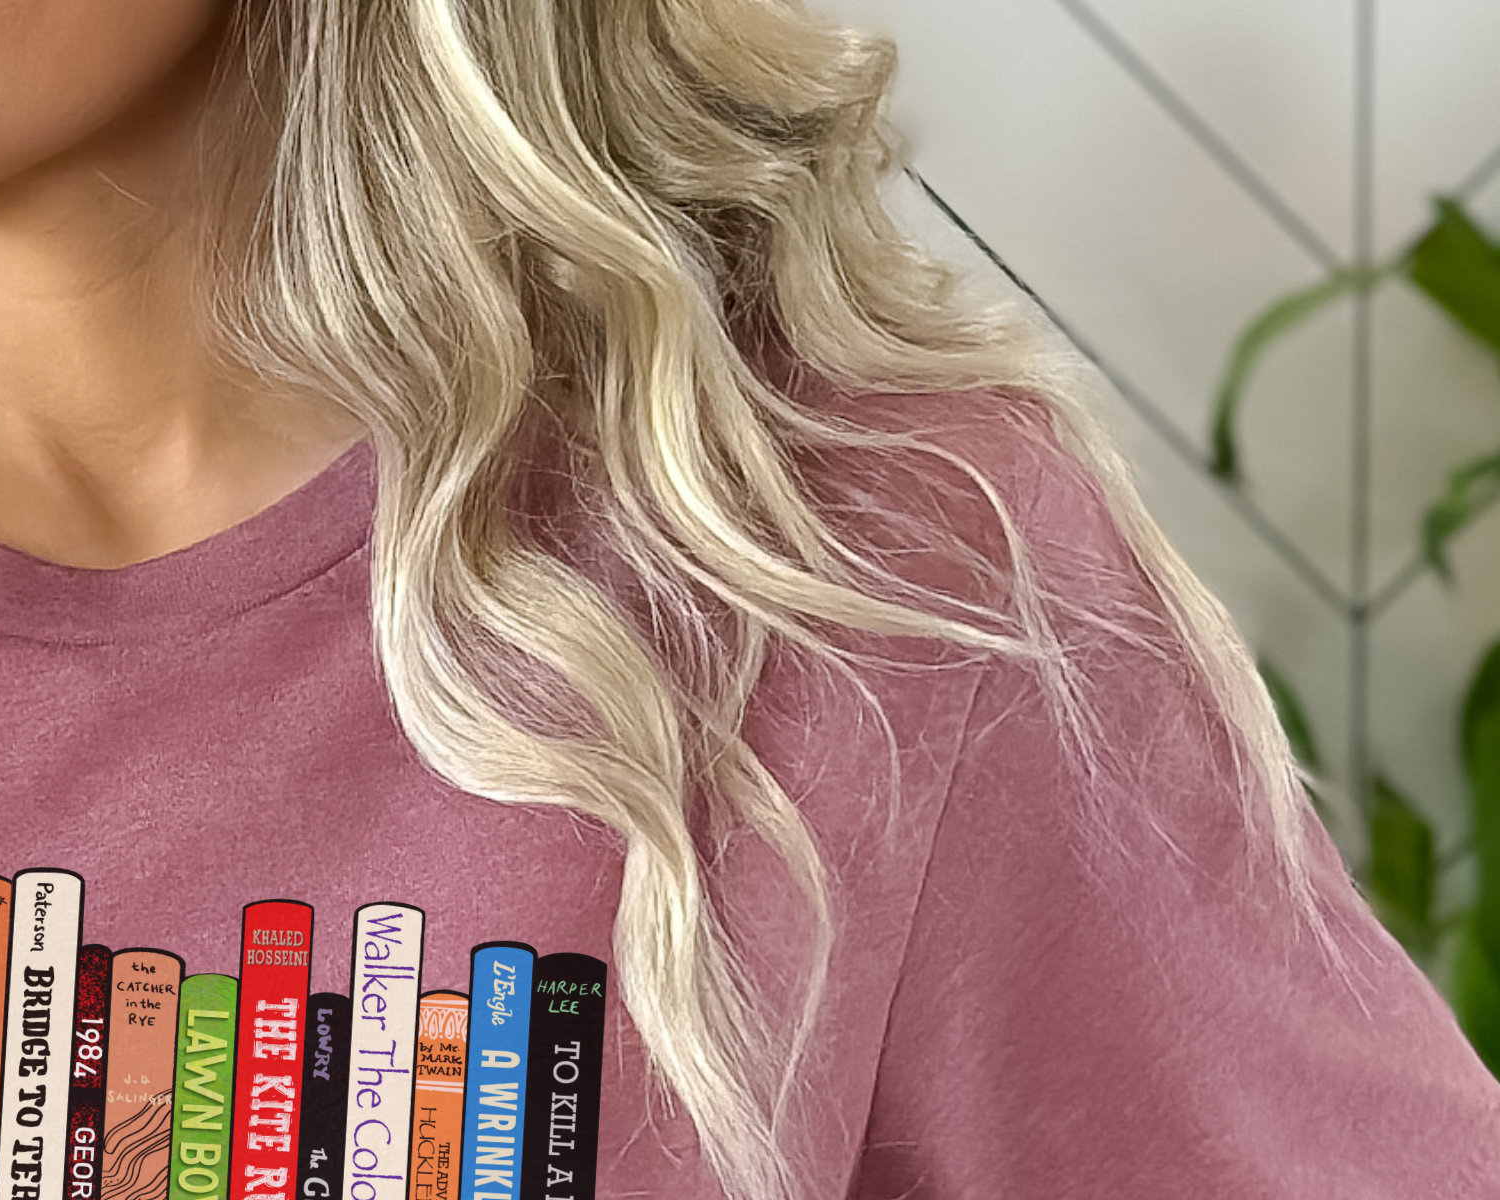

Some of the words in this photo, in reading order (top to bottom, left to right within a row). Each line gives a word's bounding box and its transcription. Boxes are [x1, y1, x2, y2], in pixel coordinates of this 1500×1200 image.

[30, 882, 54, 952] Paterson
[252, 929, 305, 947] KHALED
[132, 962, 156, 974] the
[247, 949, 309, 967] HOSSEINI
[361, 913, 415, 1031] Walker
[116, 981, 176, 995] CATCHER
[486, 960, 517, 1026] L'Engle
[537, 980, 602, 998] HARPER
[126, 998, 138, 1008] in
[139, 999, 161, 1010] the
[548, 999, 580, 1015] LEE
[19, 965, 54, 1078] BRIDGE
[128, 1013, 156, 1027] RYE
[252, 997, 299, 1061] THE
[73, 1018, 104, 1079] 1984
[420, 1054, 462, 1065] MARK
[481, 1049, 520, 1069] A
[181, 1009, 230, 1131] LAWN
[356, 1039, 409, 1108] The
[417, 1065, 462, 1076] TWAIN
[553, 1041, 581, 1084] TO
[15, 1084, 46, 1127] TO
[107, 1090, 173, 1106] SALINGER
[247, 1073, 295, 1152] KITE
[548, 1092, 578, 1156] KILL
[437, 1142, 450, 1169] THE
[546, 1164, 573, 1187] A
